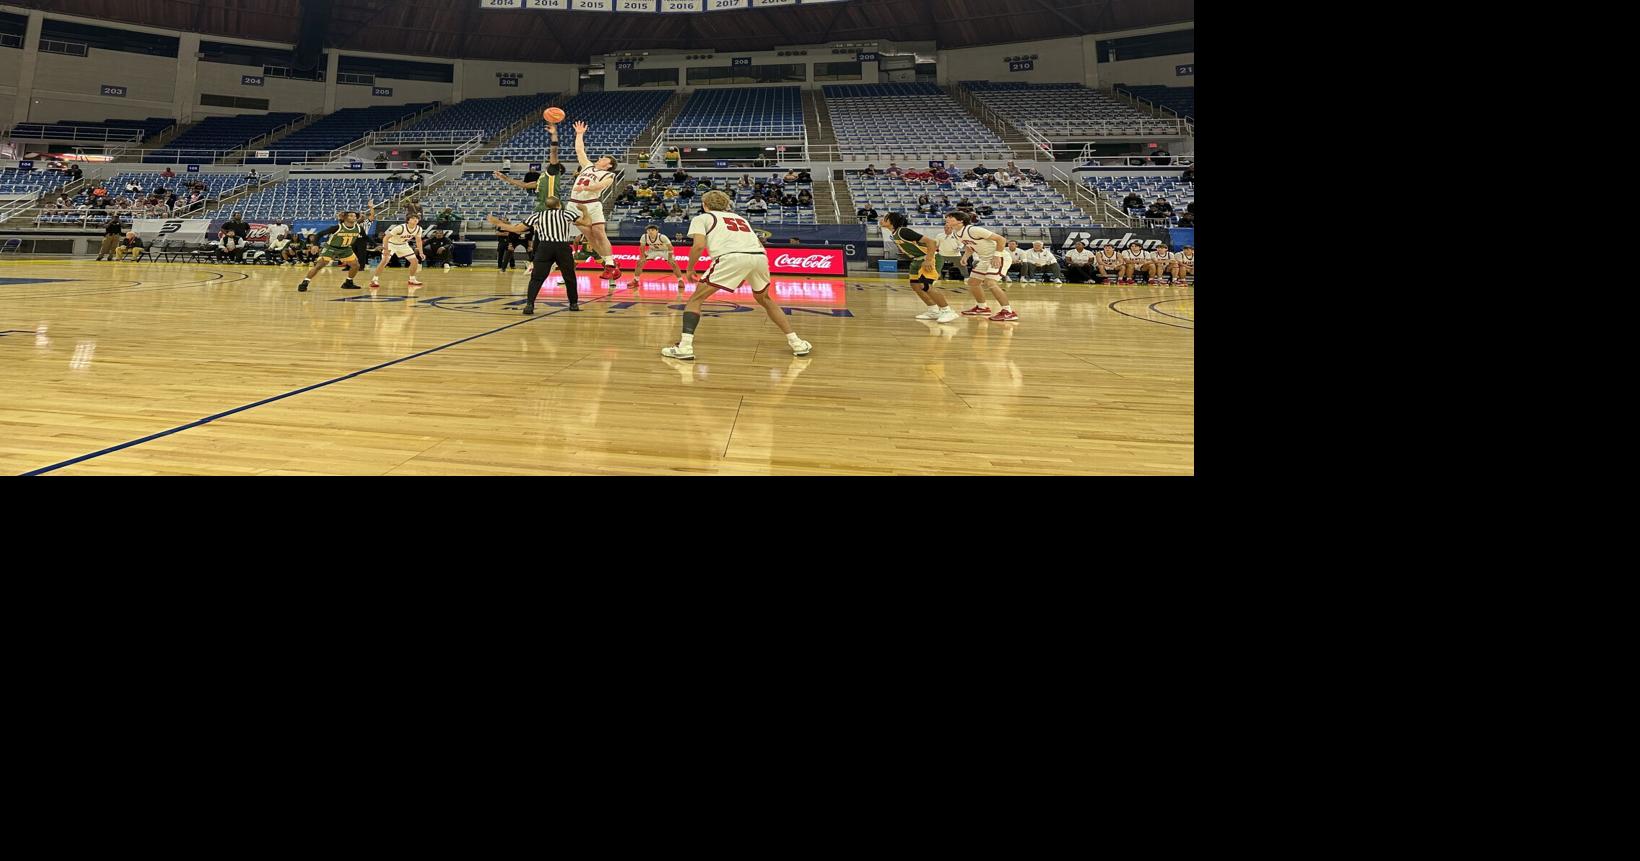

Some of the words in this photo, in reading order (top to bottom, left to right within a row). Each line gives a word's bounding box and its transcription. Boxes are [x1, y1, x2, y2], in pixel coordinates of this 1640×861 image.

[580, 1, 604, 9] 2015
[624, 2, 648, 10] 2015
[716, 0, 739, 8] 2017
[104, 87, 123, 95] 203
[722, 216, 752, 233] 55
[1062, 232, 1162, 249] Baden
[774, 253, 834, 269] Coca-Cola
